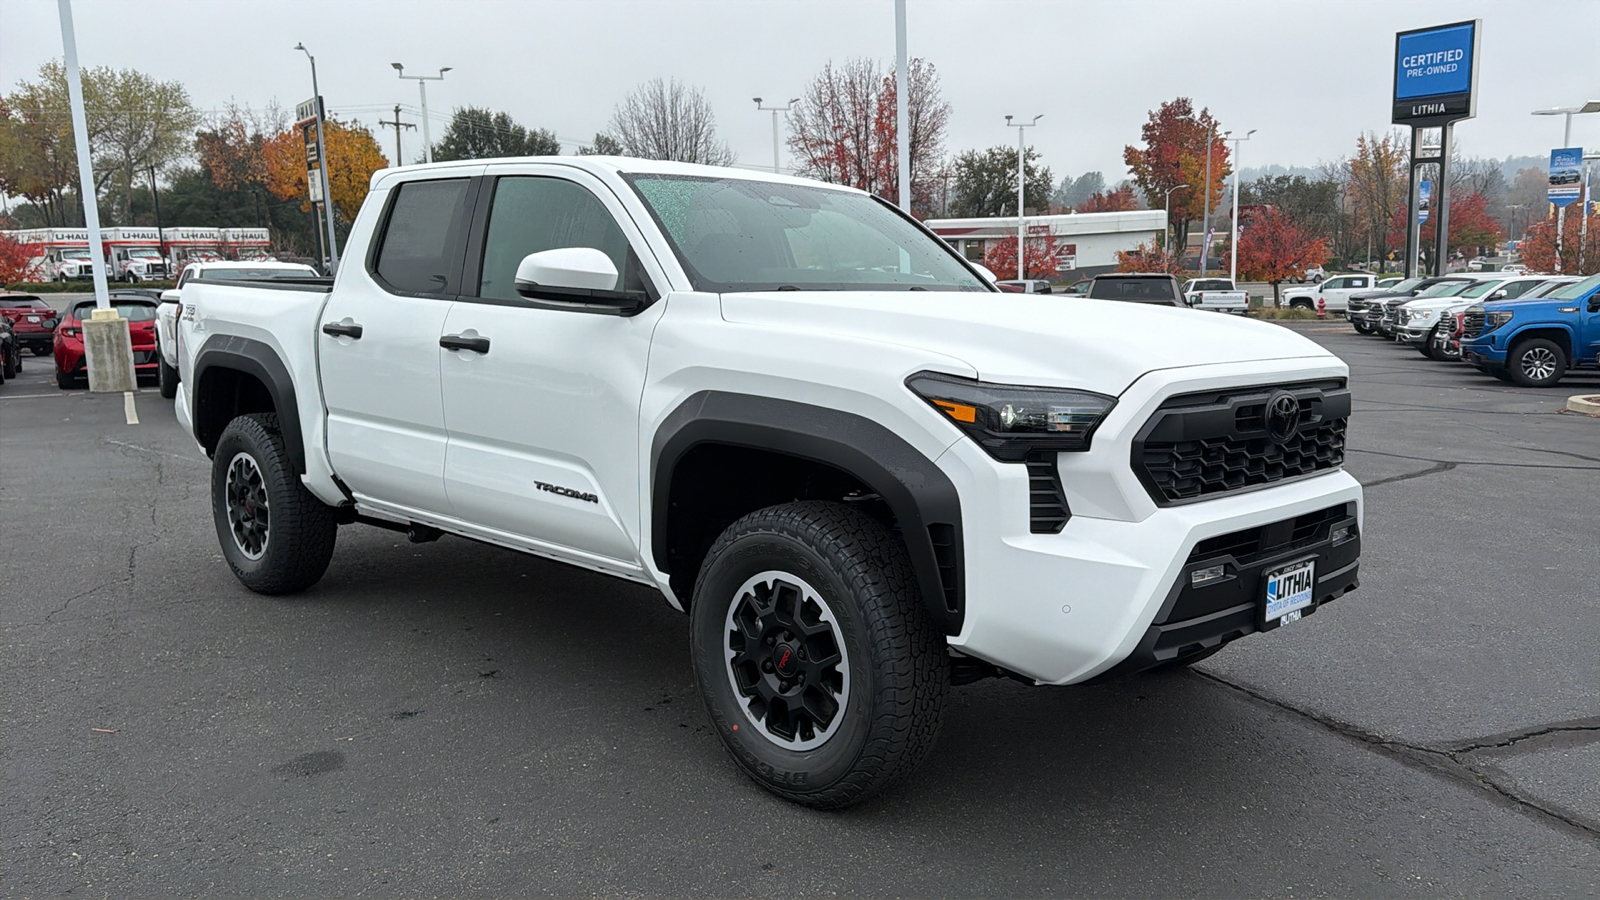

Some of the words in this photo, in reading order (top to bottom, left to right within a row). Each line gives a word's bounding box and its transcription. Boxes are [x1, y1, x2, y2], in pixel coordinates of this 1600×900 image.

[1402, 49, 1464, 68] CERTIFIED
[1406, 63, 1458, 78] PRE-OWNED
[1412, 103, 1446, 115] LITHIA
[122, 232, 159, 240] U-HAUL
[181, 232, 218, 240] U-HAUL
[533, 480, 598, 504] TACOMA
[1277, 570, 1311, 600] LITHIA
